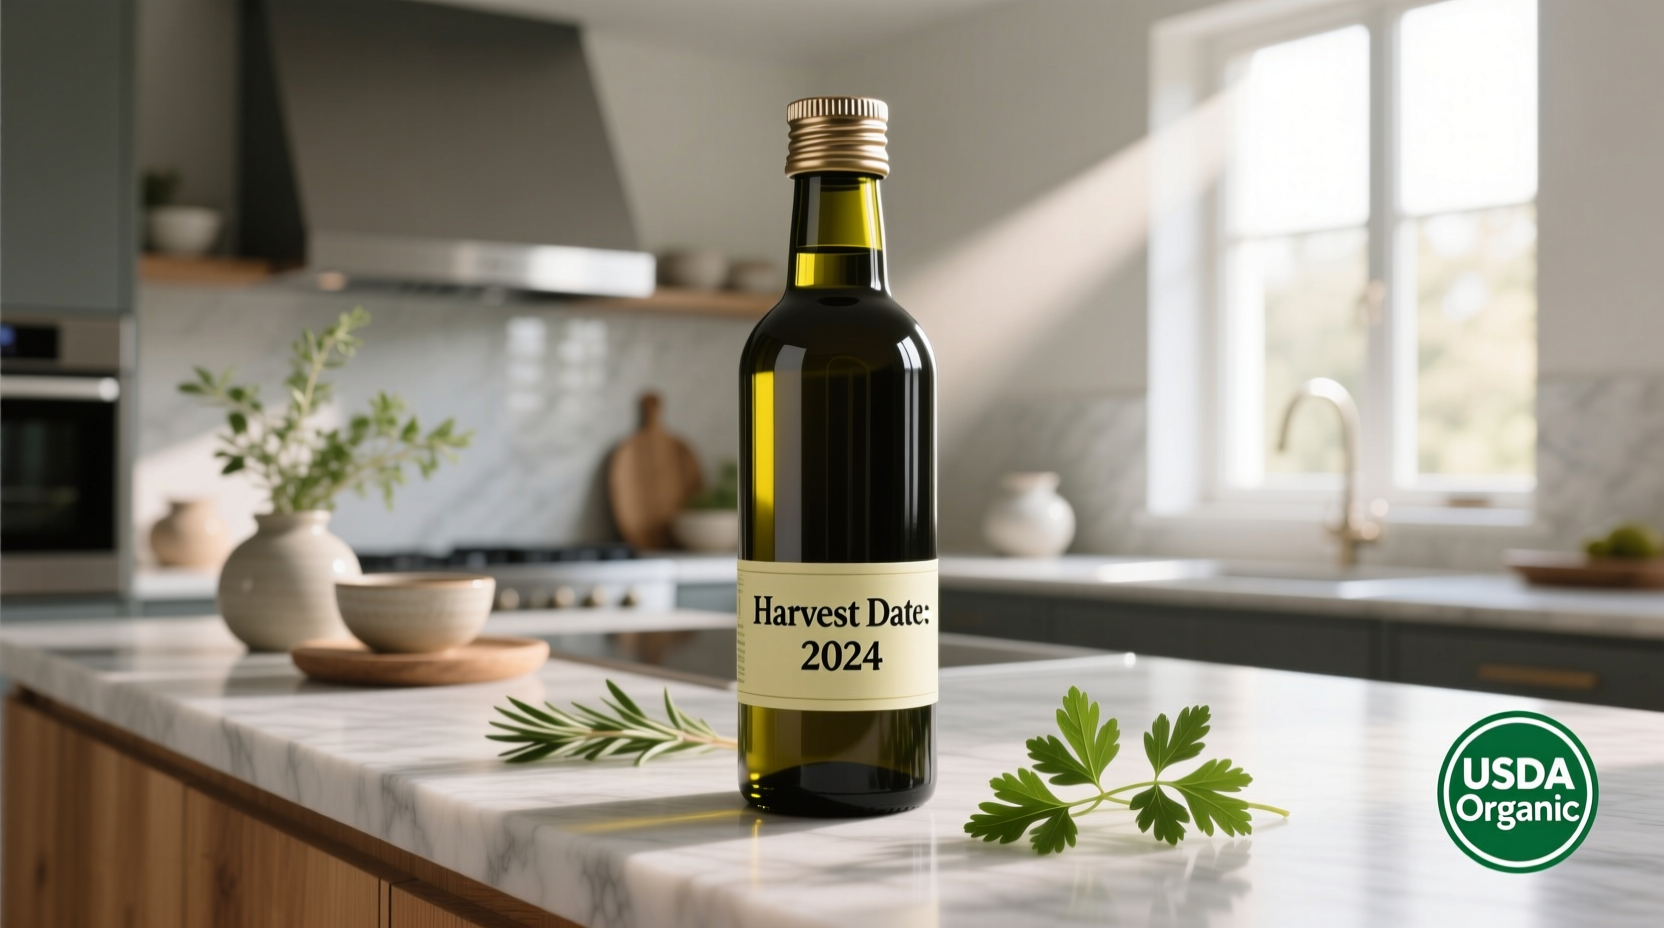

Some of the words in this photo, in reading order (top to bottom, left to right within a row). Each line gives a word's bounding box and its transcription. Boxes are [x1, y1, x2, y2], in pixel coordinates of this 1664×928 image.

[753, 595, 860, 627] Harvest
[866, 598, 930, 627] Date:
[801, 640, 883, 671] 2024
